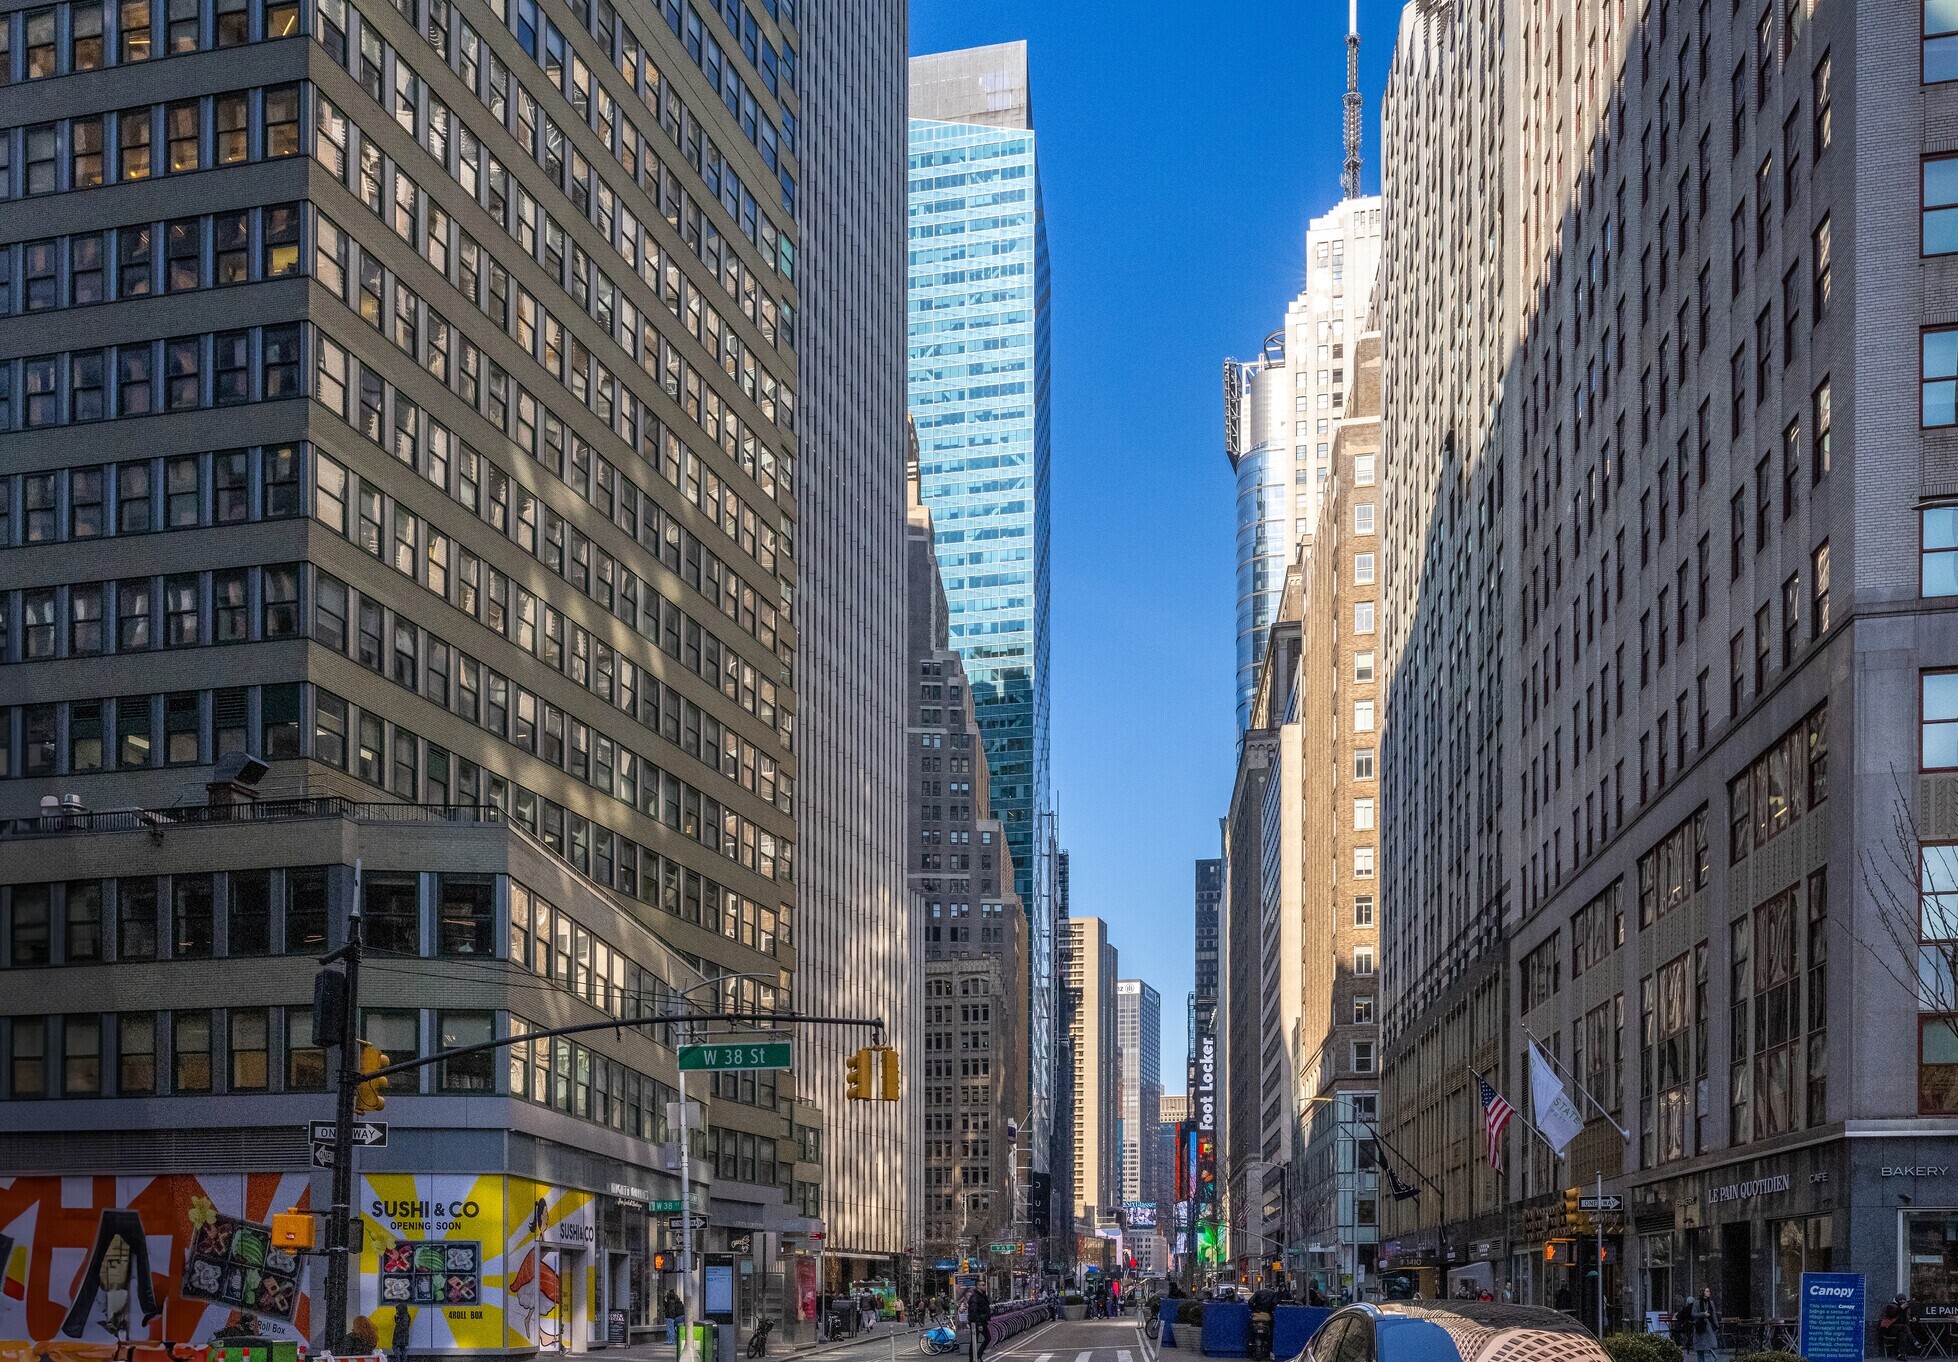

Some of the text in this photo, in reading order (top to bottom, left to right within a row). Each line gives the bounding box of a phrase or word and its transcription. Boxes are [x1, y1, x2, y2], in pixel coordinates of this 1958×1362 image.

[704, 1048, 765, 1065] W 38 St
[1200, 1096, 1214, 1130] Foot
[1554, 1098, 1580, 1124] STATE
[321, 1128, 376, 1138] ON WAY
[1881, 1166, 1949, 1176] BAKERY
[1708, 1174, 1790, 1204] LE PAIN QUOTIDIEN
[372, 1200, 480, 1218] SUSHI & CO
[664, 1201, 673, 1210] 38
[390, 1222, 461, 1230] OPENING SOON
[560, 1222, 579, 1240] SUSHI
[585, 1227, 594, 1242] CO
[1810, 1286, 1854, 1297] Canopy
[470, 1311, 483, 1319] BOX
[1926, 1306, 1936, 1314] LE
[272, 1324, 285, 1334] Box
